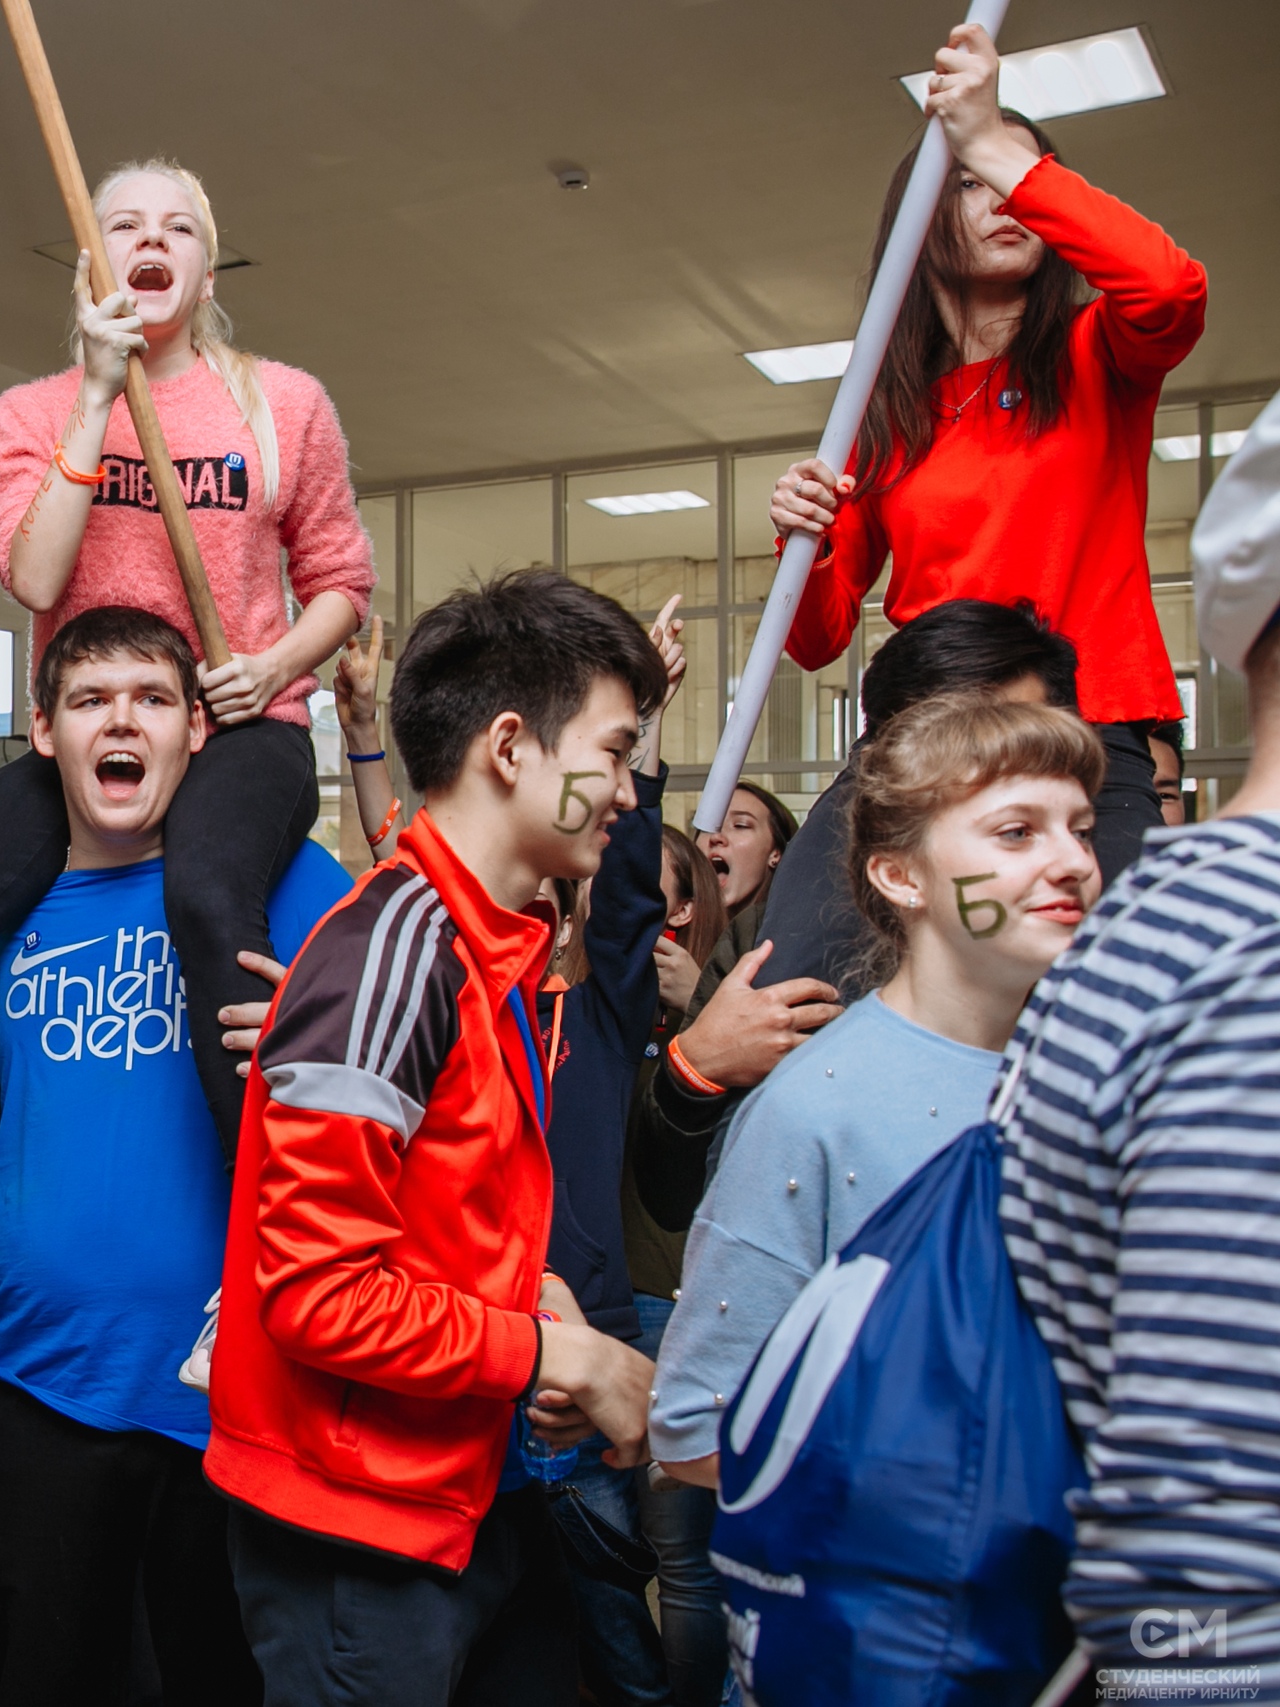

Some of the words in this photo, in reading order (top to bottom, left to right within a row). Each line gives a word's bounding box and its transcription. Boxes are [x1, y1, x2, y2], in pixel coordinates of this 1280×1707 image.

[96, 457, 243, 508] RIGNAL
[552, 770, 607, 836] Б
[951, 871, 1008, 941] Б
[114, 925, 175, 973] th
[5, 958, 187, 1020] athleti
